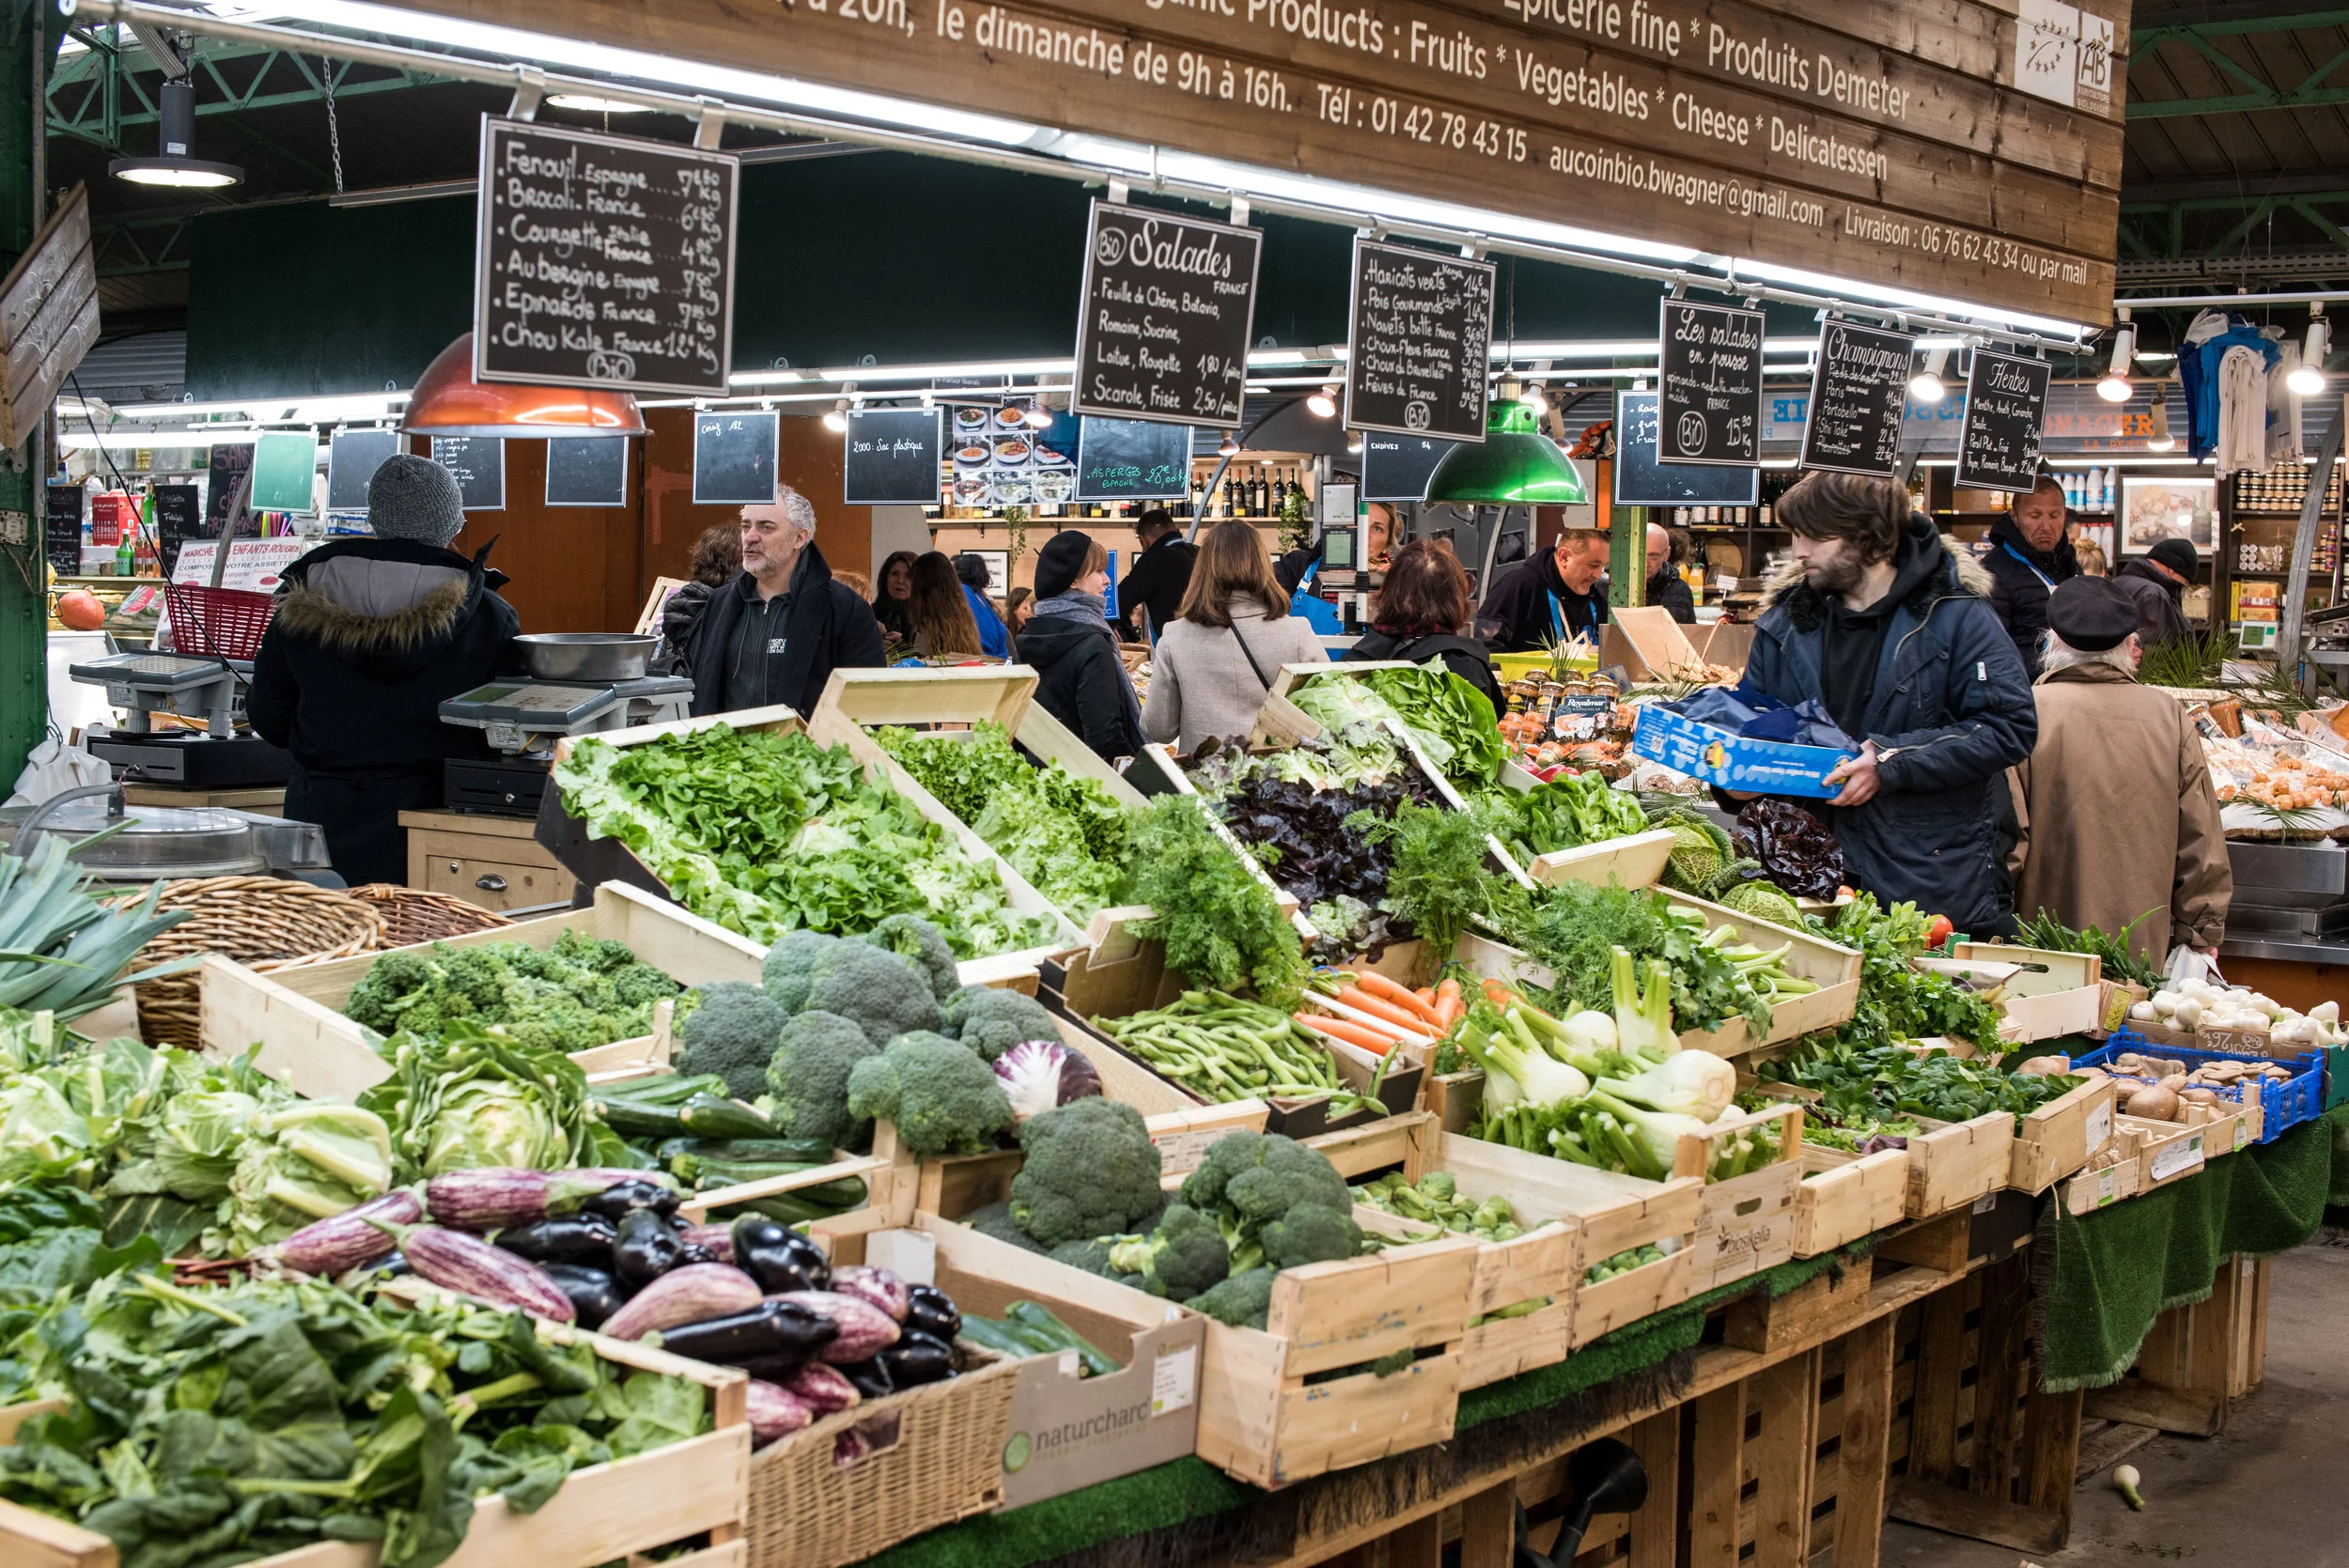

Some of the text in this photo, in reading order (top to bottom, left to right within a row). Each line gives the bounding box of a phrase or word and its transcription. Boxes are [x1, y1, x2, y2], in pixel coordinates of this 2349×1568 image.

[1504, 0, 1909, 119] picerie fine Produits Demeter
[2081, 38, 2106, 85] AB
[1248, 0, 1887, 180] Products Fruits Vegetables Cheese Delicatessen
[2077, 86, 2110, 103] AGRICULTURE
[2077, 98, 2110, 115] BIOLOGIQUE
[938, 0, 964, 40] le
[975, 6, 1124, 74] dimanche
[1133, 41, 1168, 85] de
[1178, 52, 1211, 95] 9h
[1220, 60, 1235, 100] à
[1244, 67, 1292, 112] 16h.
[1317, 84, 1351, 125] Tél
[1372, 97, 1397, 135] 01
[1404, 105, 1433, 143] 42
[1440, 112, 1466, 148] 78
[1472, 120, 1501, 156] 43
[1506, 128, 1527, 163] 15
[1550, 145, 1824, 227] aucoinbio.bwagner@gmail.com
[1845, 206, 1909, 246] Livraison
[1921, 225, 1939, 253] 06
[1944, 229, 1960, 256] 76
[1964, 234, 1980, 261] 62
[1983, 239, 1999, 265] 43
[2002, 242, 2018, 270] 34
[2021, 253, 2037, 274] ou
[2040, 256, 2060, 280] par
[2062, 261, 2087, 286] mail
[584, 163, 648, 197] Espagne
[586, 190, 646, 217] France
[511, 213, 603, 258] Courgette
[1129, 218, 1231, 277] Salades
[507, 250, 609, 300] Aubergine
[1214, 281, 1248, 295] FRANCE
[1367, 258, 1416, 288] Haricots
[1417, 266, 1446, 290] verts
[603, 302, 656, 324] France
[1101, 277, 1131, 303] Feuille
[1134, 287, 1143, 304] de
[1182, 292, 1221, 319] Batavia,
[1368, 287, 1390, 310] Pois
[503, 323, 556, 350] Chou
[561, 324, 602, 351] Kale
[614, 332, 663, 355] France
[1099, 310, 1180, 344] Romaine, Sucrine,
[1367, 312, 1406, 335] Navets
[1410, 314, 1433, 337] botte
[1675, 308, 1758, 350] Les salades
[1097, 341, 1135, 370] Laitue,
[1139, 348, 1181, 379] Rougette
[1366, 354, 1395, 372] Choux
[1396, 360, 1405, 375] de
[1423, 343, 1451, 359] France
[1828, 328, 1908, 377] Champignons
[1688, 348, 1750, 390] en pousse
[1987, 361, 2030, 393] Herbes
[1094, 374, 1146, 411] Scarole,
[1150, 384, 1181, 410] Frisée
[1396, 380, 1406, 396] de
[1409, 383, 1438, 401] France
[1706, 397, 1730, 411] FRANCE
[1826, 379, 1844, 398] Paris
[1824, 398, 1858, 419] Portobello
[877, 439, 890, 452] Sac
[894, 438, 924, 458] plastique
[2083, 440, 2100, 450] LA
[1091, 466, 1142, 478] ASPERGES
[183, 543, 300, 557] MARCHÉ ENFANTS ROUGES
[1567, 698, 1606, 708] Royalmar
[1035, 1398, 1150, 1451] naturcharc
